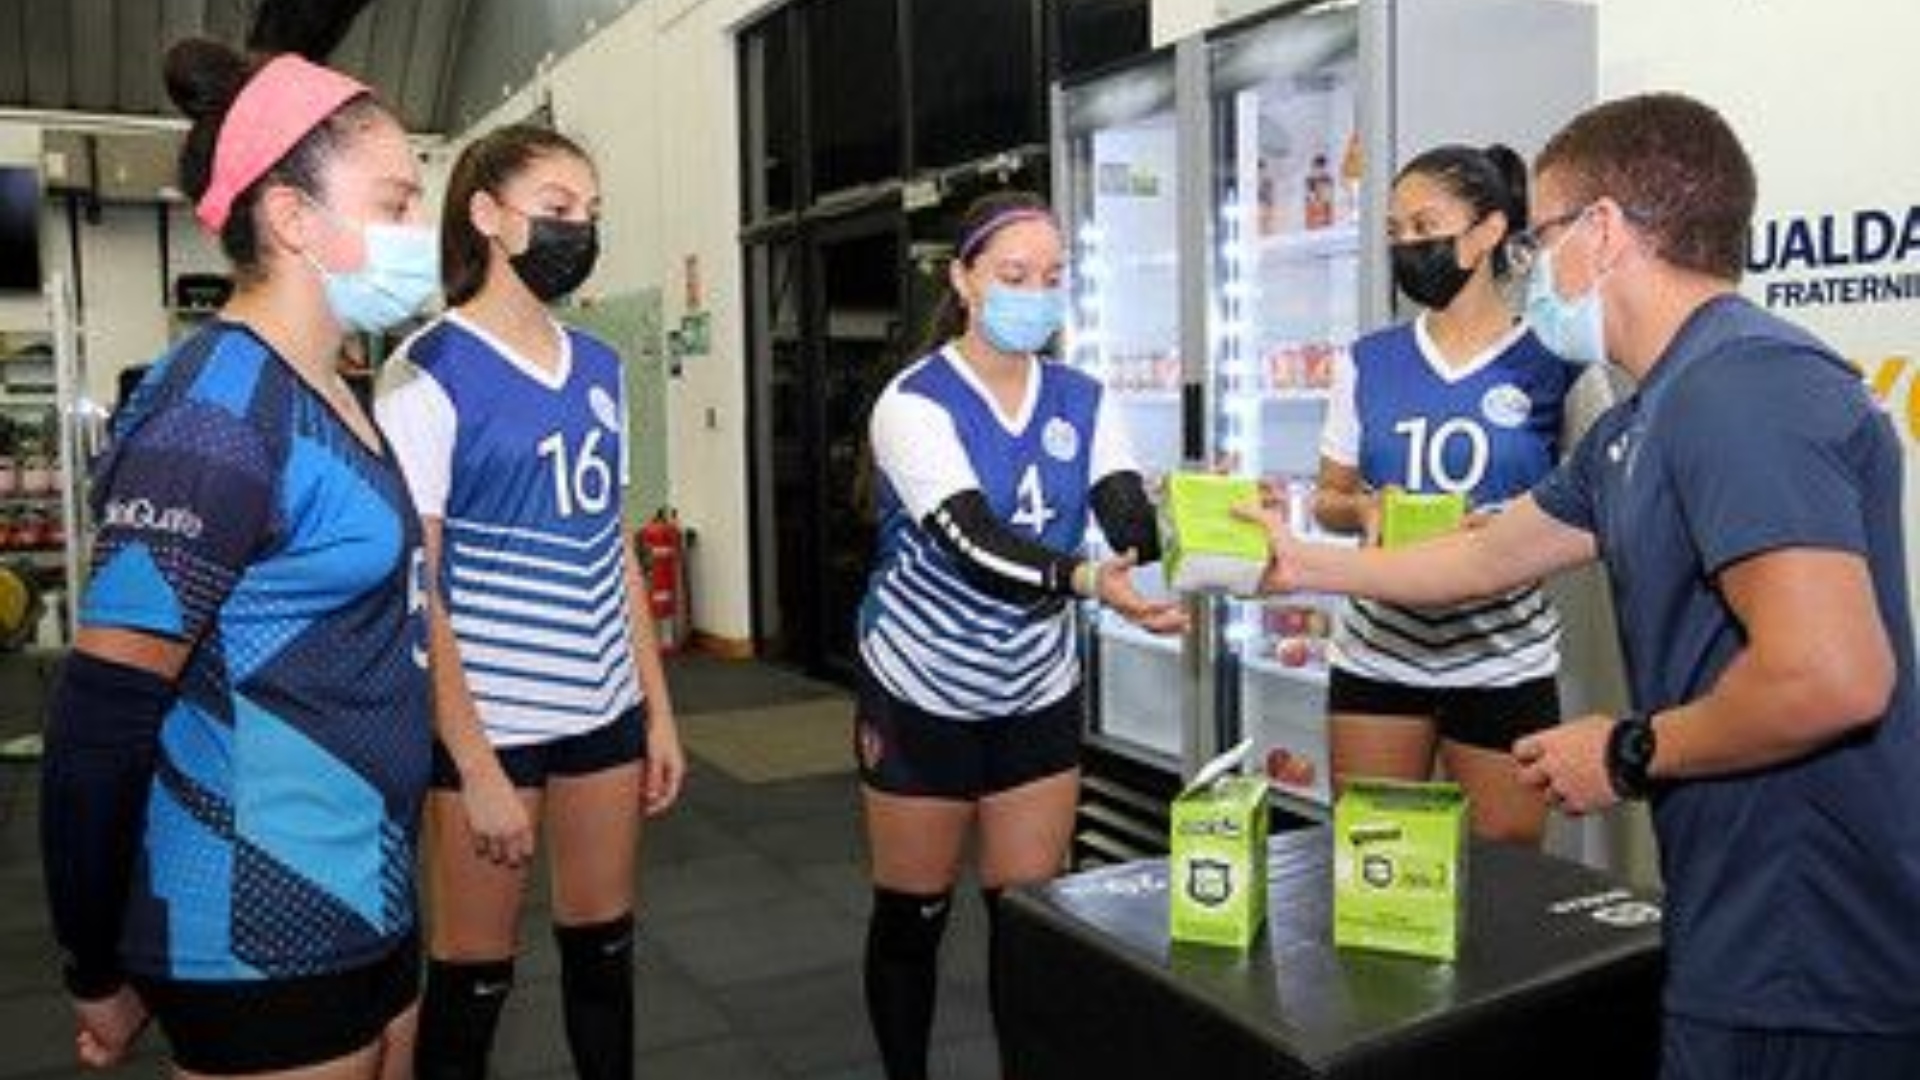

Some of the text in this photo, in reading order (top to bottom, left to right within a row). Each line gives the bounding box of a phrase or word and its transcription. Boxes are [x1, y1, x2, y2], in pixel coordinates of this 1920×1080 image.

[537, 429, 611, 518] 16
[1394, 416, 1490, 493] 10
[1011, 463, 1057, 535] 4
